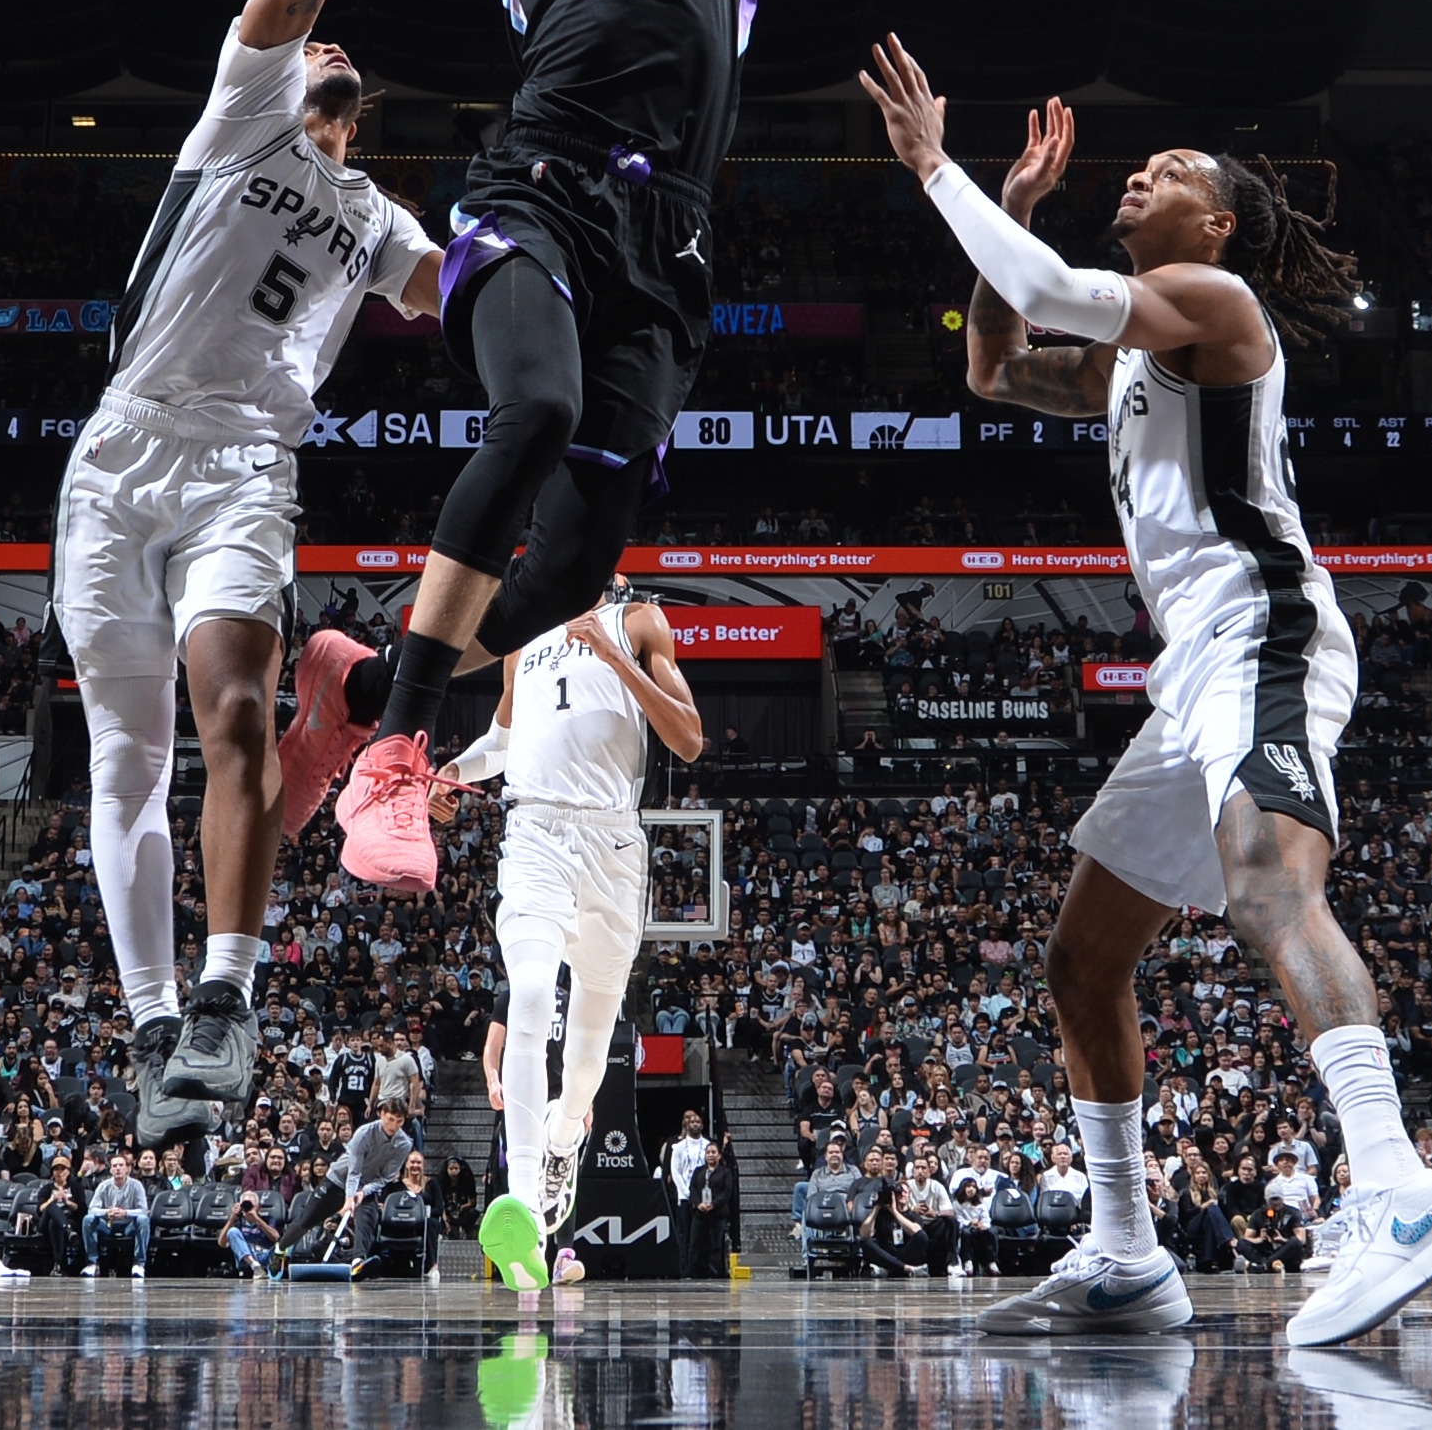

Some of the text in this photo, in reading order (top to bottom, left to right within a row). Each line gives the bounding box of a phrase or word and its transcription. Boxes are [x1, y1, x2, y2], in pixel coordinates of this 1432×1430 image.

[241, 176, 369, 286] SPURS
[249, 250, 311, 326] 5
[26, 309, 74, 332] LA
[7, 417, 18, 439] 4
[384, 413, 433, 444] SA
[698, 417, 732, 445] 80
[765, 415, 838, 446] UTA
[980, 421, 1043, 444] PF 2
[1288, 418, 1315, 428] BLK
[1333, 417, 1360, 428] STL
[1378, 417, 1406, 428] AST
[1299, 432, 1304, 447] 1
[1343, 432, 1352, 447] 4
[1387, 432, 1400, 447] 22
[710, 554, 736, 566] Here
[829, 554, 871, 566] Better
[1012, 554, 1045, 566] Here
[1312, 553, 1341, 565] Here
[1344, 553, 1424, 567] Everything's
[986, 583, 1012, 598] 101
[713, 625, 778, 642] Better
[523, 641, 593, 674] SPUR
[556, 677, 571, 710] 1
[917, 700, 1049, 720] BASELINE BUMS
[347, 1076, 365, 1091] 21
[596, 1152, 634, 1168] Frost
